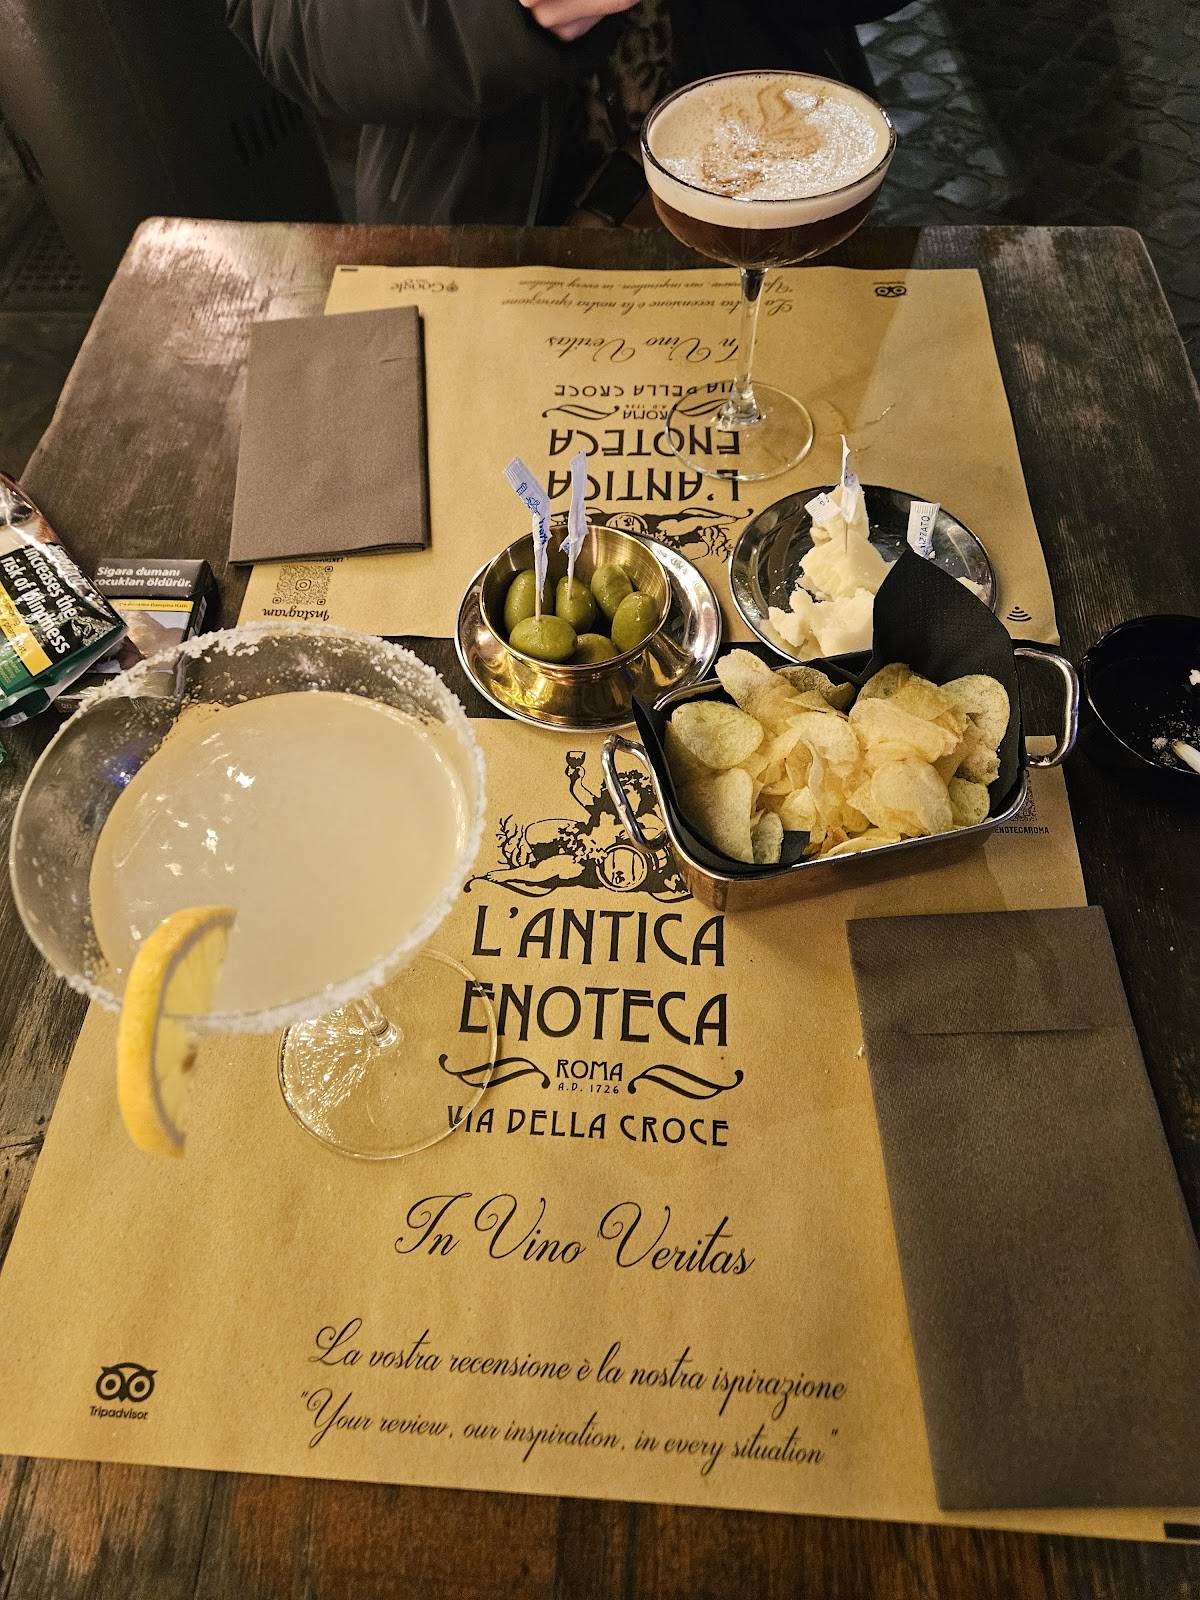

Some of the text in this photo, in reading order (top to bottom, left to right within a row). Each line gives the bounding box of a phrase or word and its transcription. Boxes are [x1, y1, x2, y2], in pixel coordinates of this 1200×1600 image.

[546, 336, 635, 363] Veritas
[645, 336, 711, 363] Vino
[554, 384, 624, 397] CROCE
[623, 410, 669, 420] ROMA
[549, 424, 740, 457] ENOTECA
[1, 555, 26, 580] risk
[97, 566, 180, 578] Sigara dumanı
[14, 576, 37, 592] of
[146, 577, 192, 588] öldürür.
[56, 594, 77, 619] the
[263, 606, 329, 621] Instagram
[22, 587, 70, 654] blindness
[472, 905, 725, 966] L'ANTICA
[458, 980, 728, 1047] ENOTECA
[556, 1059, 623, 1081] ROMA
[558, 1082, 620, 1094] A.D. 1726
[447, 1105, 729, 1146] VIA DELLA CROCE
[394, 1192, 756, 1275] In Vino Veritas
[308, 1317, 848, 1421] La vostra recensione è la nostra ispirazione
[89, 1405, 149, 1420] Tripadvisor
[463, 1423, 501, 1439] our
[634, 1429, 659, 1451] in
[664, 1436, 727, 1477] every
